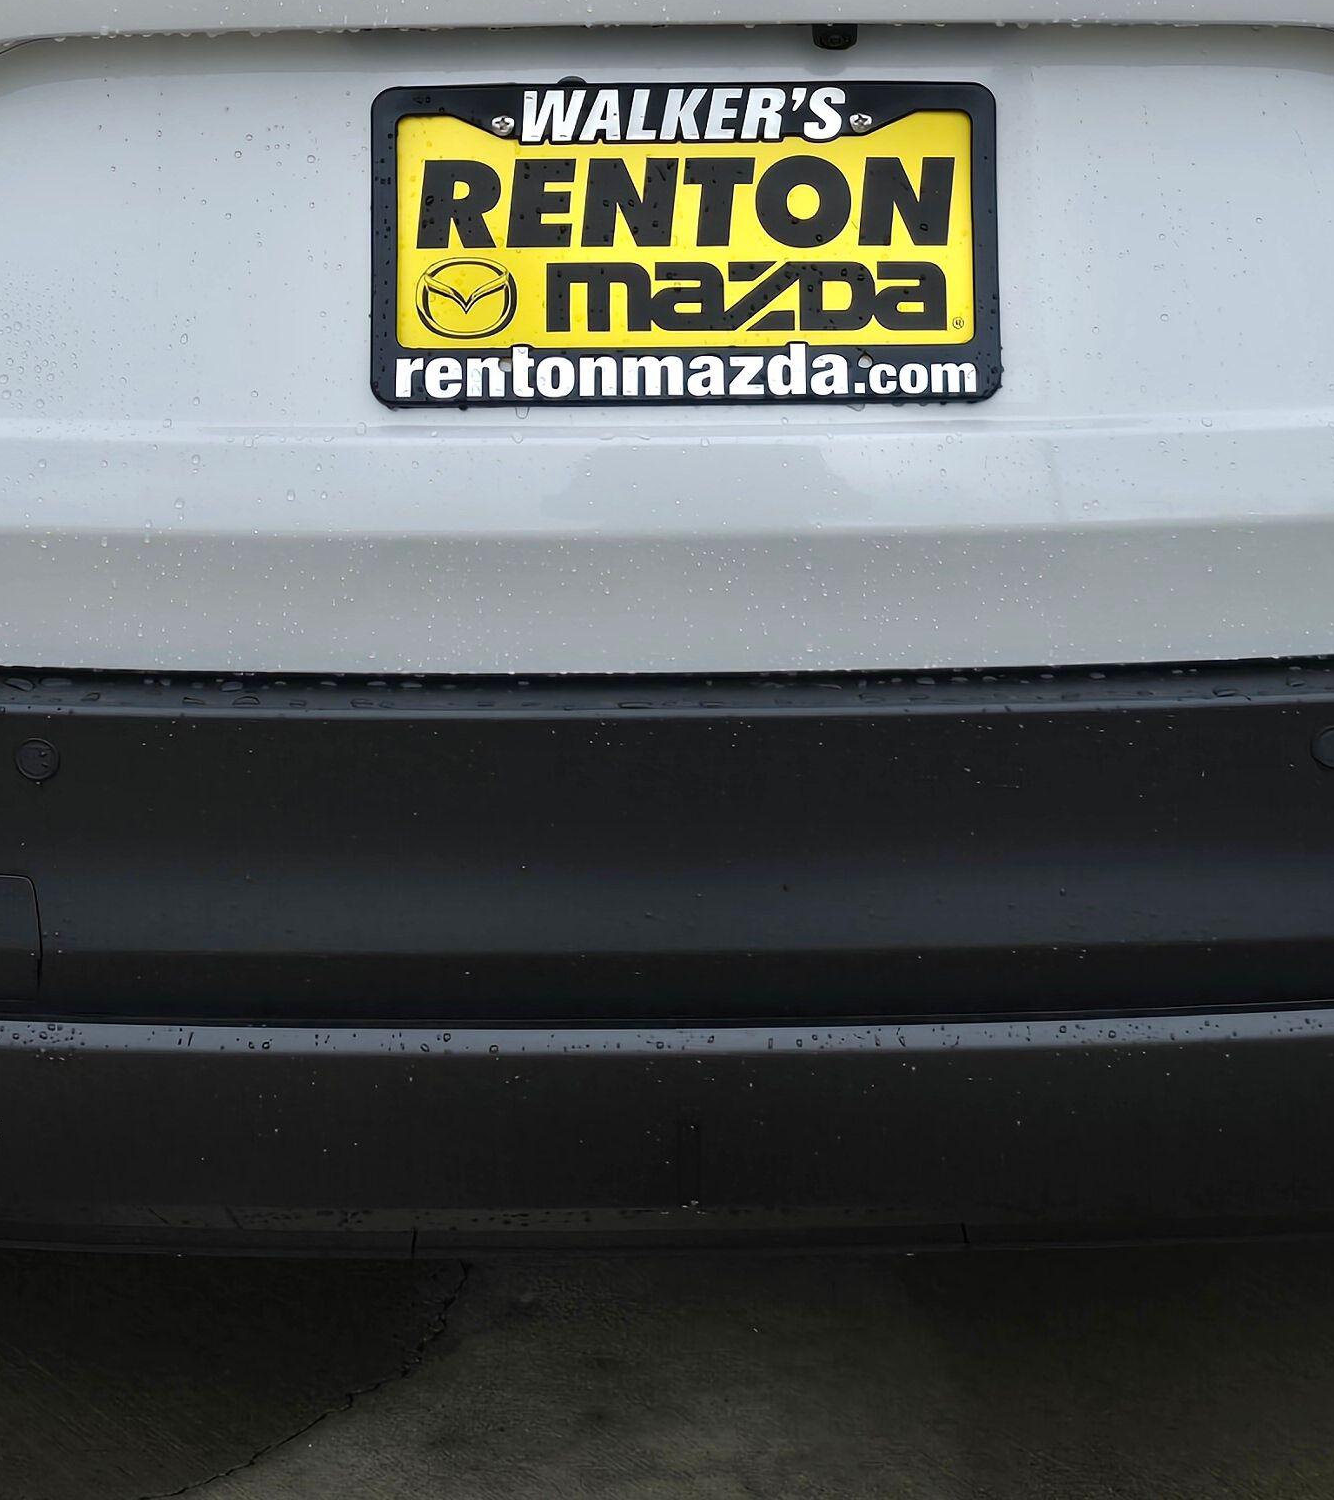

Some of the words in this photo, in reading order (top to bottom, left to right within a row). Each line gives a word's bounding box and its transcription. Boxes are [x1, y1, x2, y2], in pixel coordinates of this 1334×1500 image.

[520, 86, 847, 143] WALKER'S
[415, 154, 956, 249] RENTON
[393, 342, 978, 399] rentonmazda.com
